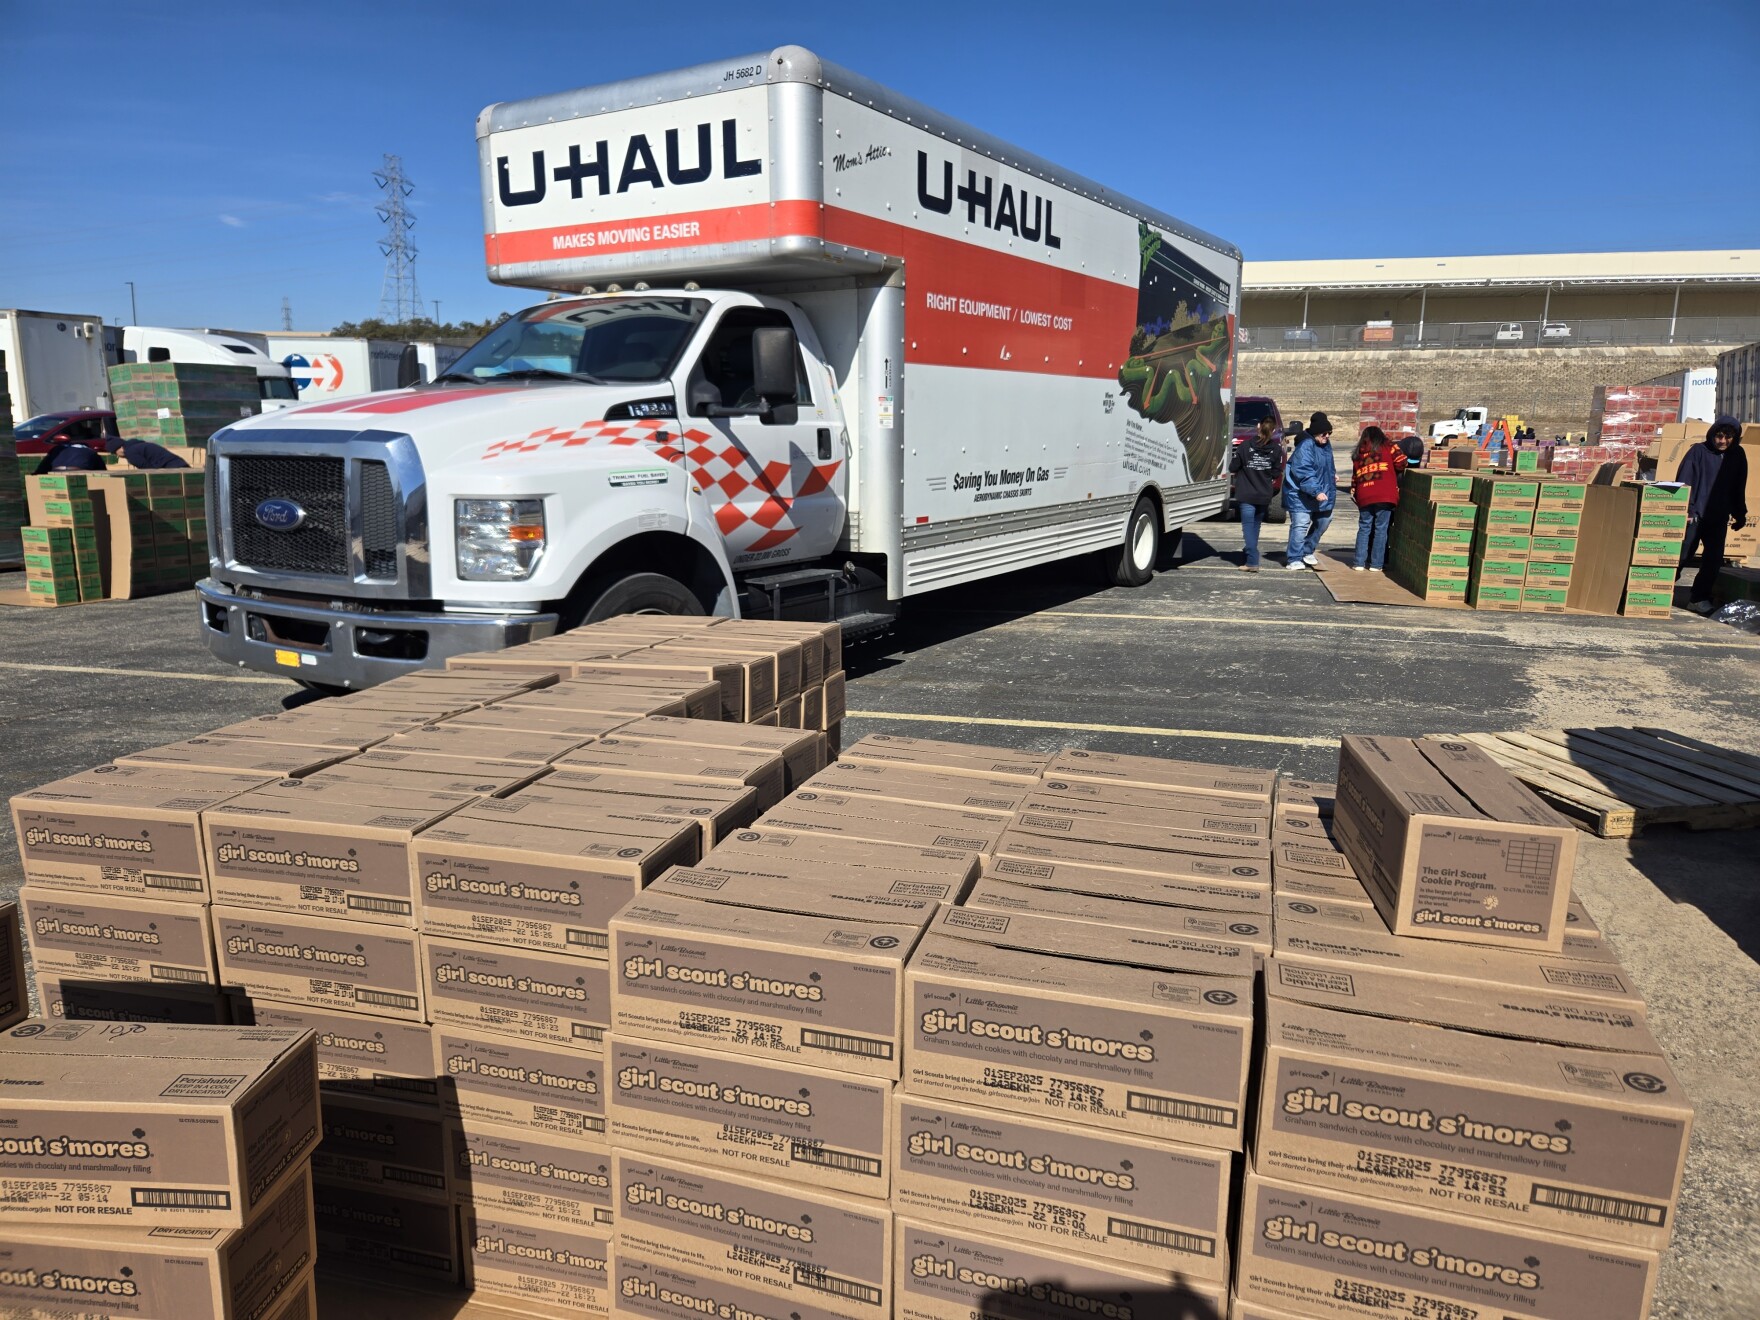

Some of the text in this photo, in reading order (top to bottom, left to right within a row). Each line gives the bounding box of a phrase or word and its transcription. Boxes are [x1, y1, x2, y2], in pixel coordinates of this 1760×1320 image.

[723, 65, 762, 81] JH 5682 D
[497, 118, 762, 207] U-HAUL
[833, 144, 887, 172] Mom's Attic
[917, 150, 1061, 250] U-HAUL
[553, 222, 700, 249] MAKES MOVING EASIER
[927, 292, 957, 312] RIGHT
[959, 298, 1011, 321] EQUIPMENT
[1020, 310, 1051, 327] LOWEST
[1054, 315, 1072, 331] COST
[984, 470, 998, 486] You
[1000, 469, 1024, 487] Money
[1025, 468, 1035, 482] On
[1037, 467, 1049, 481] Gas
[974, 488, 1032, 503] AERODYNAMIC CHASSIS SKIRTS
[262, 504, 288, 522] Ford
[24, 826, 51, 847] girl
[51, 831, 92, 847] scout
[217, 842, 246, 864] girl
[247, 847, 292, 865] scout
[425, 871, 457, 894] girl
[459, 877, 507, 897] scout
[1421, 876, 1452, 886] Cookie
[1422, 867, 1439, 875] The
[1461, 871, 1486, 880] Scout
[1419, 894, 1458, 902] entrepreneurial
[34, 916, 61, 936] girl
[61, 921, 101, 938] scout
[1415, 910, 1440, 923] girl
[1443, 914, 1481, 927] scout
[226, 934, 255, 957] girl
[256, 940, 300, 959] scout
[1288, 942, 1363, 958] DO NOT DROP
[435, 962, 466, 986] girl
[467, 969, 514, 990] scout
[624, 954, 662, 983] girl
[666, 962, 727, 988] scout
[922, 1006, 966, 1039] girl
[971, 1016, 1041, 1045] scout
[731, 1035, 801, 1054] NOT FOR RESALE
[447, 1053, 477, 1077] girl
[479, 1061, 525, 1082] scout
[179, 1077, 238, 1085] Perishable
[618, 1064, 655, 1094] girl
[659, 1074, 718, 1101] scout
[1045, 1097, 1127, 1119] NOT FOR RESALE
[1283, 1084, 1340, 1121] girl
[1344, 1097, 1433, 1131] scout
[908, 1128, 952, 1161] girl
[956, 1140, 1025, 1171] scout
[1284, 1114, 1567, 1172] Graham sandwich cookies with chocolaty and marshmallowy filling
[490, 1154, 537, 1175] scout
[1357, 1149, 1432, 1173] 01SEP2025
[2, 1181, 57, 1191] 01SEP2025
[1463, 1179, 1506, 1197] 14:53
[55, 1205, 133, 1215] NOT FOR RESALE
[626, 1179, 662, 1211] girl
[666, 1191, 723, 1221] scout
[1429, 1186, 1530, 1213] NOT FOR RESALE
[1263, 1212, 1318, 1249] girl
[1322, 1227, 1407, 1263] scout
[507, 1241, 553, 1262] scout
[912, 1251, 954, 1284] girl
[959, 1264, 1026, 1297] scout
[621, 1273, 715, 1315] girl scout
